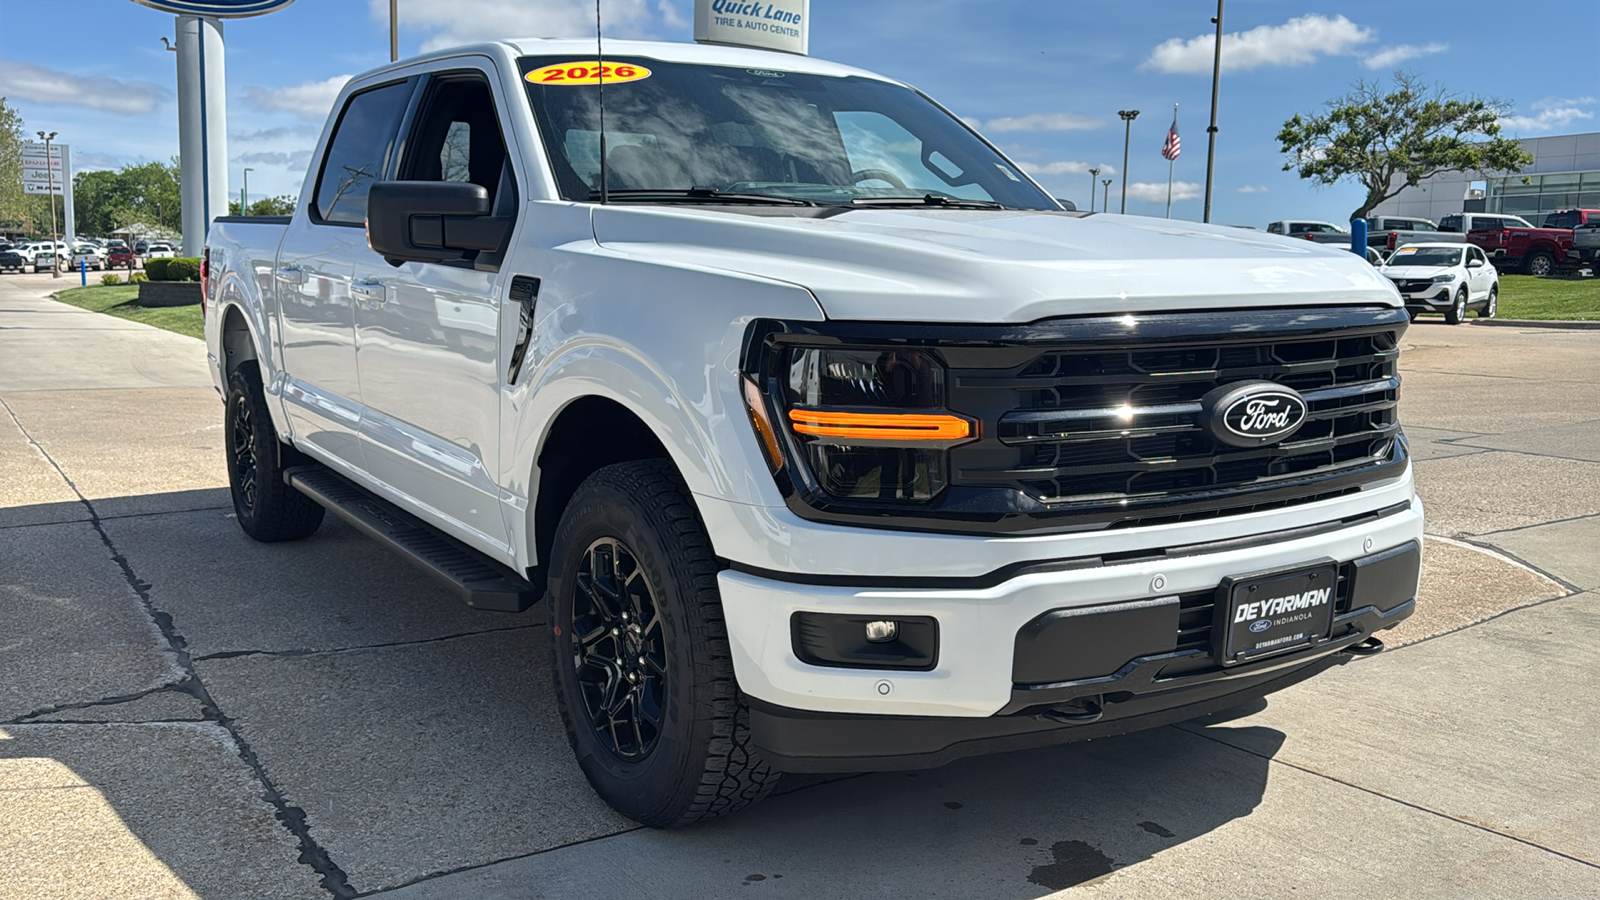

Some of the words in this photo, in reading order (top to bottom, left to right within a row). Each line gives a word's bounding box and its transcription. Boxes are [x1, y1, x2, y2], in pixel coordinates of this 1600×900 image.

[711, 0, 763, 17] Quick
[763, 4, 801, 25] Lane
[714, 17, 735, 27] TIRE
[736, 19, 743, 29] &
[744, 20, 769, 32] AUTO
[769, 24, 800, 38] CENTER
[542, 66, 636, 82] 2026
[1240, 399, 1292, 431] Ford
[1234, 587, 1331, 623] DEYARMAN
[1273, 612, 1312, 626] INDIANOLA
